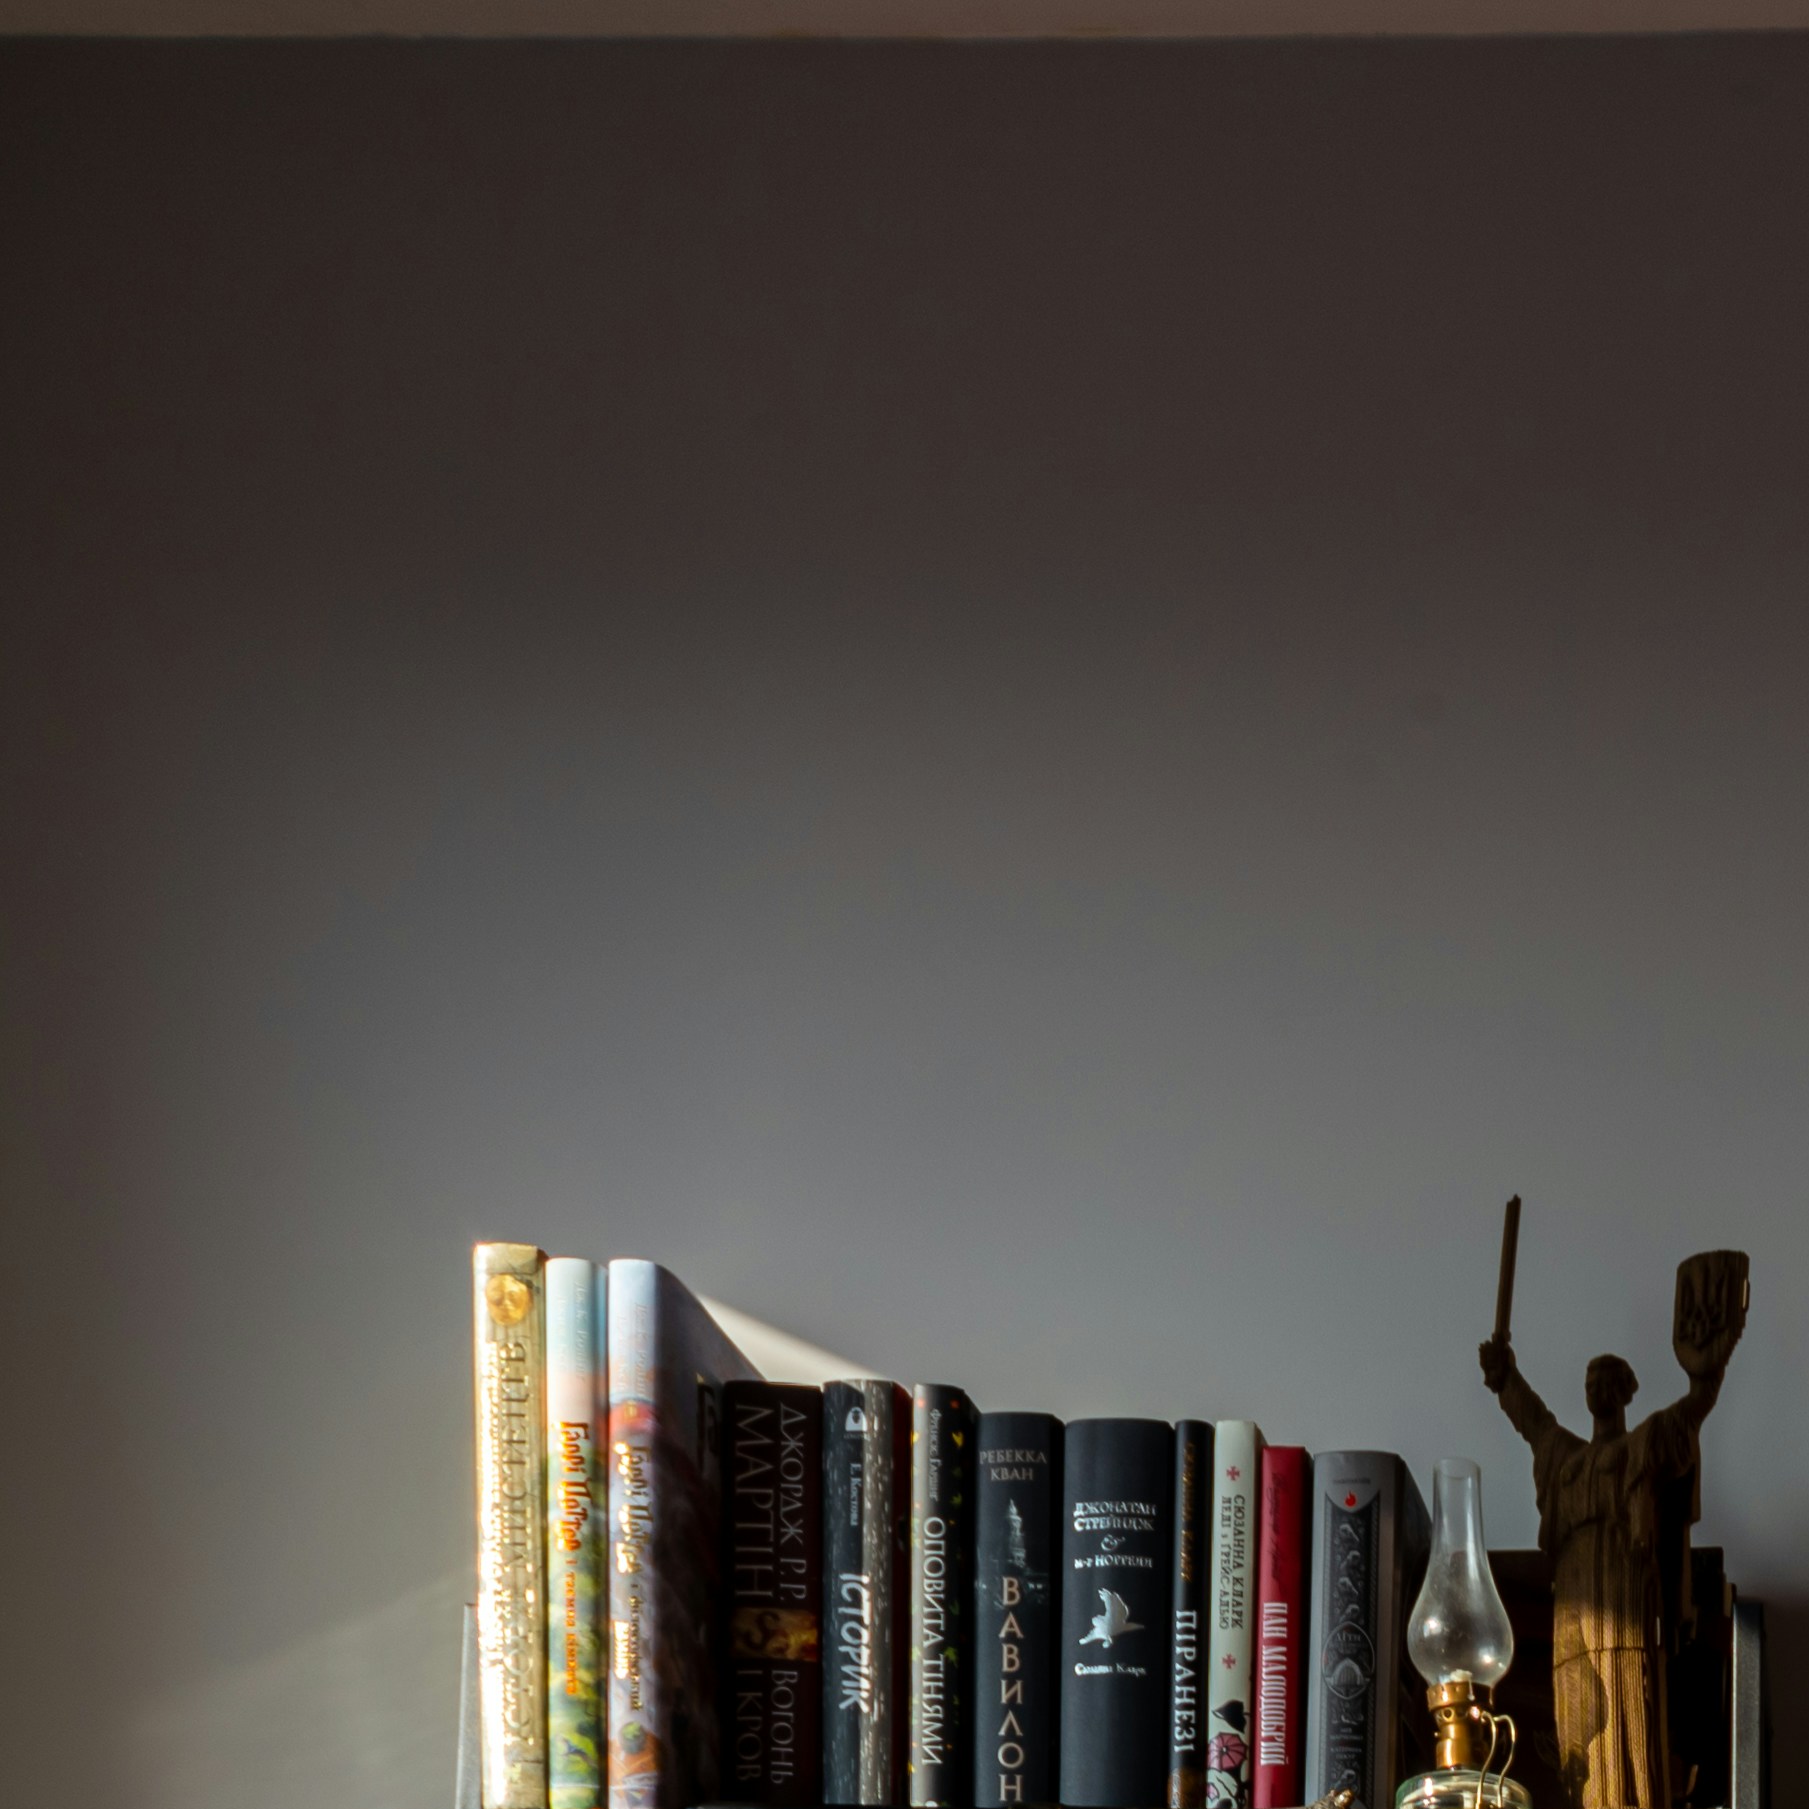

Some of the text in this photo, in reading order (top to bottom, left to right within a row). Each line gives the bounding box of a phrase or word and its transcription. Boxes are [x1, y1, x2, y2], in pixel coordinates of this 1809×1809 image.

[554, 1421, 592, 1551] Гаррі Поттер
[735, 1402, 774, 1598] МАРТІН
[979, 1449, 1048, 1464] РЕБЕККА
[990, 1467, 1034, 1481] КВАН
[1073, 1501, 1157, 1517] ДЖОНАТАН
[1230, 1494, 1245, 1629] СЮЗАННА КЛАРК
[1262, 1601, 1288, 1639] ПАН
[839, 1573, 870, 1714] ІСТОРИК
[920, 1516, 946, 1765] ОПОВИТА ТІНЯМИ
[997, 1576, 1025, 1800] ВАВИЛОН
[1173, 1609, 1197, 1753] ПІРАНЕЗІ
[736, 1692, 763, 1782] КРОВ
[770, 1669, 799, 1784] ВОГОНЬ
[1258, 1644, 1288, 1766] МАЛОДОБРИЙ
